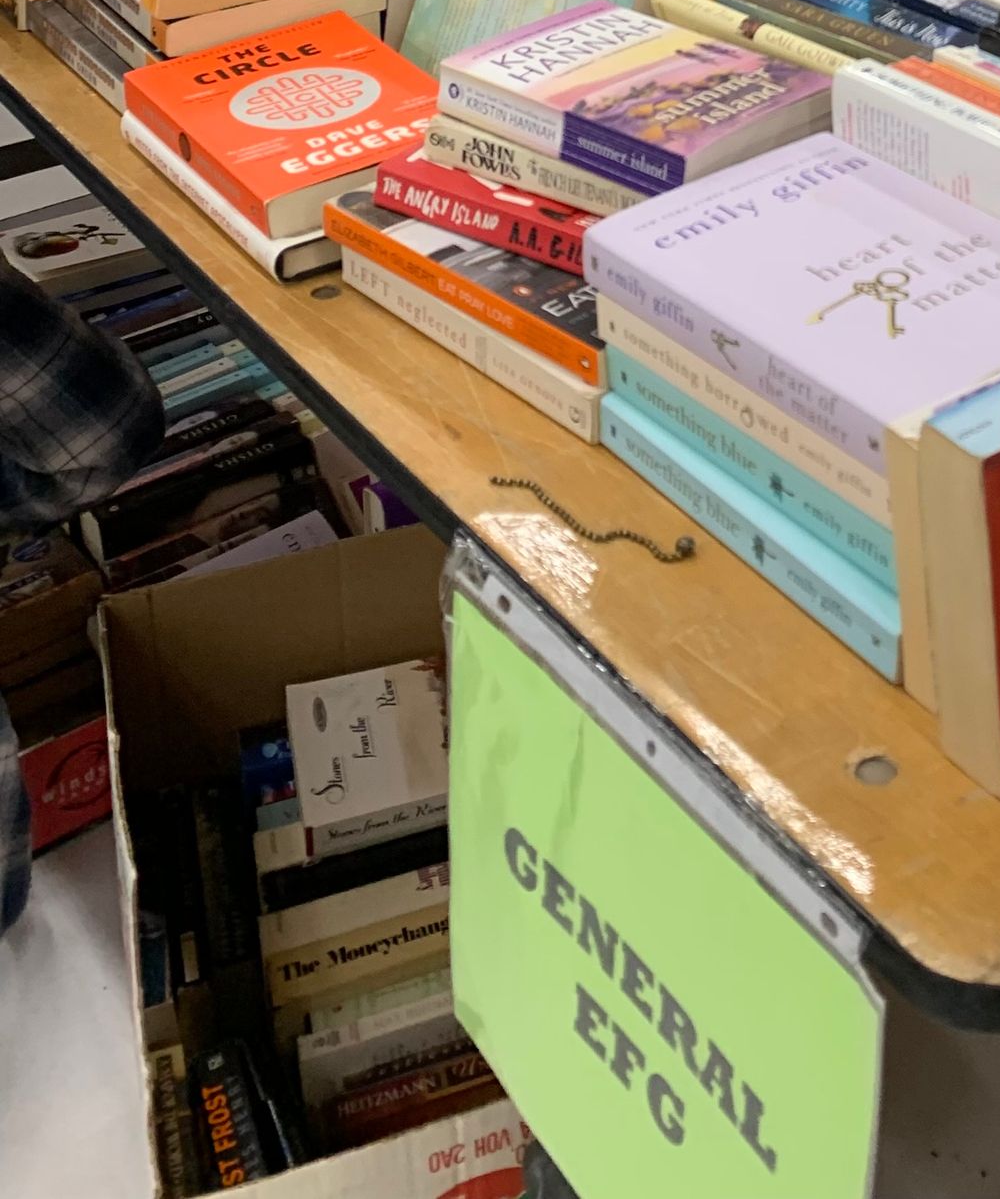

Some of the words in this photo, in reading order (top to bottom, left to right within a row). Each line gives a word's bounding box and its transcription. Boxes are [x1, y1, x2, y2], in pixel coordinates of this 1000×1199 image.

[219, 43, 272, 64] THE
[492, 12, 631, 70] KRISTIN
[507, 19, 664, 84] HANNAH
[828, 11, 895, 47] GRUEN
[193, 43, 322, 86] CIRCLE
[465, 97, 507, 124] KRISTIN
[509, 113, 557, 144] HANNAH
[654, 68, 772, 126] summer
[699, 81, 787, 126] island
[280, 116, 437, 175] EGGERS
[304, 119, 385, 149] DAVE
[464, 134, 516, 165] JOHN
[577, 134, 626, 167] summer
[629, 153, 669, 181] island
[461, 149, 521, 181] FOWLES
[381, 176, 402, 200] THE
[404, 186, 448, 219] ANGRY
[451, 200, 499, 232] ISLAND
[508, 222, 543, 253] A.A.
[653, 196, 759, 252] emily
[771, 153, 871, 204] giffin
[804, 232, 914, 283] heart
[934, 229, 993, 262] the
[331, 218, 386, 261] ELIZABETH
[387, 251, 437, 286] GILBERT
[438, 279, 457, 296] EAT
[459, 289, 484, 310] PRAY
[486, 304, 515, 329] LOVE
[350, 260, 390, 296] LEFT
[397, 294, 468, 350] neglected
[606, 265, 647, 306] emily
[650, 293, 695, 334] giffin
[767, 356, 812, 397] heart
[818, 389, 840, 415] of
[623, 321, 700, 390] something
[758, 373, 785, 399] the
[790, 399, 848, 444] matter
[214, 440, 275, 472] GEISHA
[636, 379, 717, 451] something
[720, 431, 758, 476] blue
[803, 499, 843, 535] emily
[847, 532, 890, 569] giffin
[625, 435, 704, 512] something
[705, 489, 742, 536] blue
[376, 676, 398, 713] River
[309, 755, 347, 805] Stones
[279, 960, 320, 983] The
[504, 827, 779, 1175] GENERAL
[573, 982, 689, 1148] EFG
[201, 1084, 237, 1153] FROST
[337, 1072, 437, 1119] HEITZMANN
